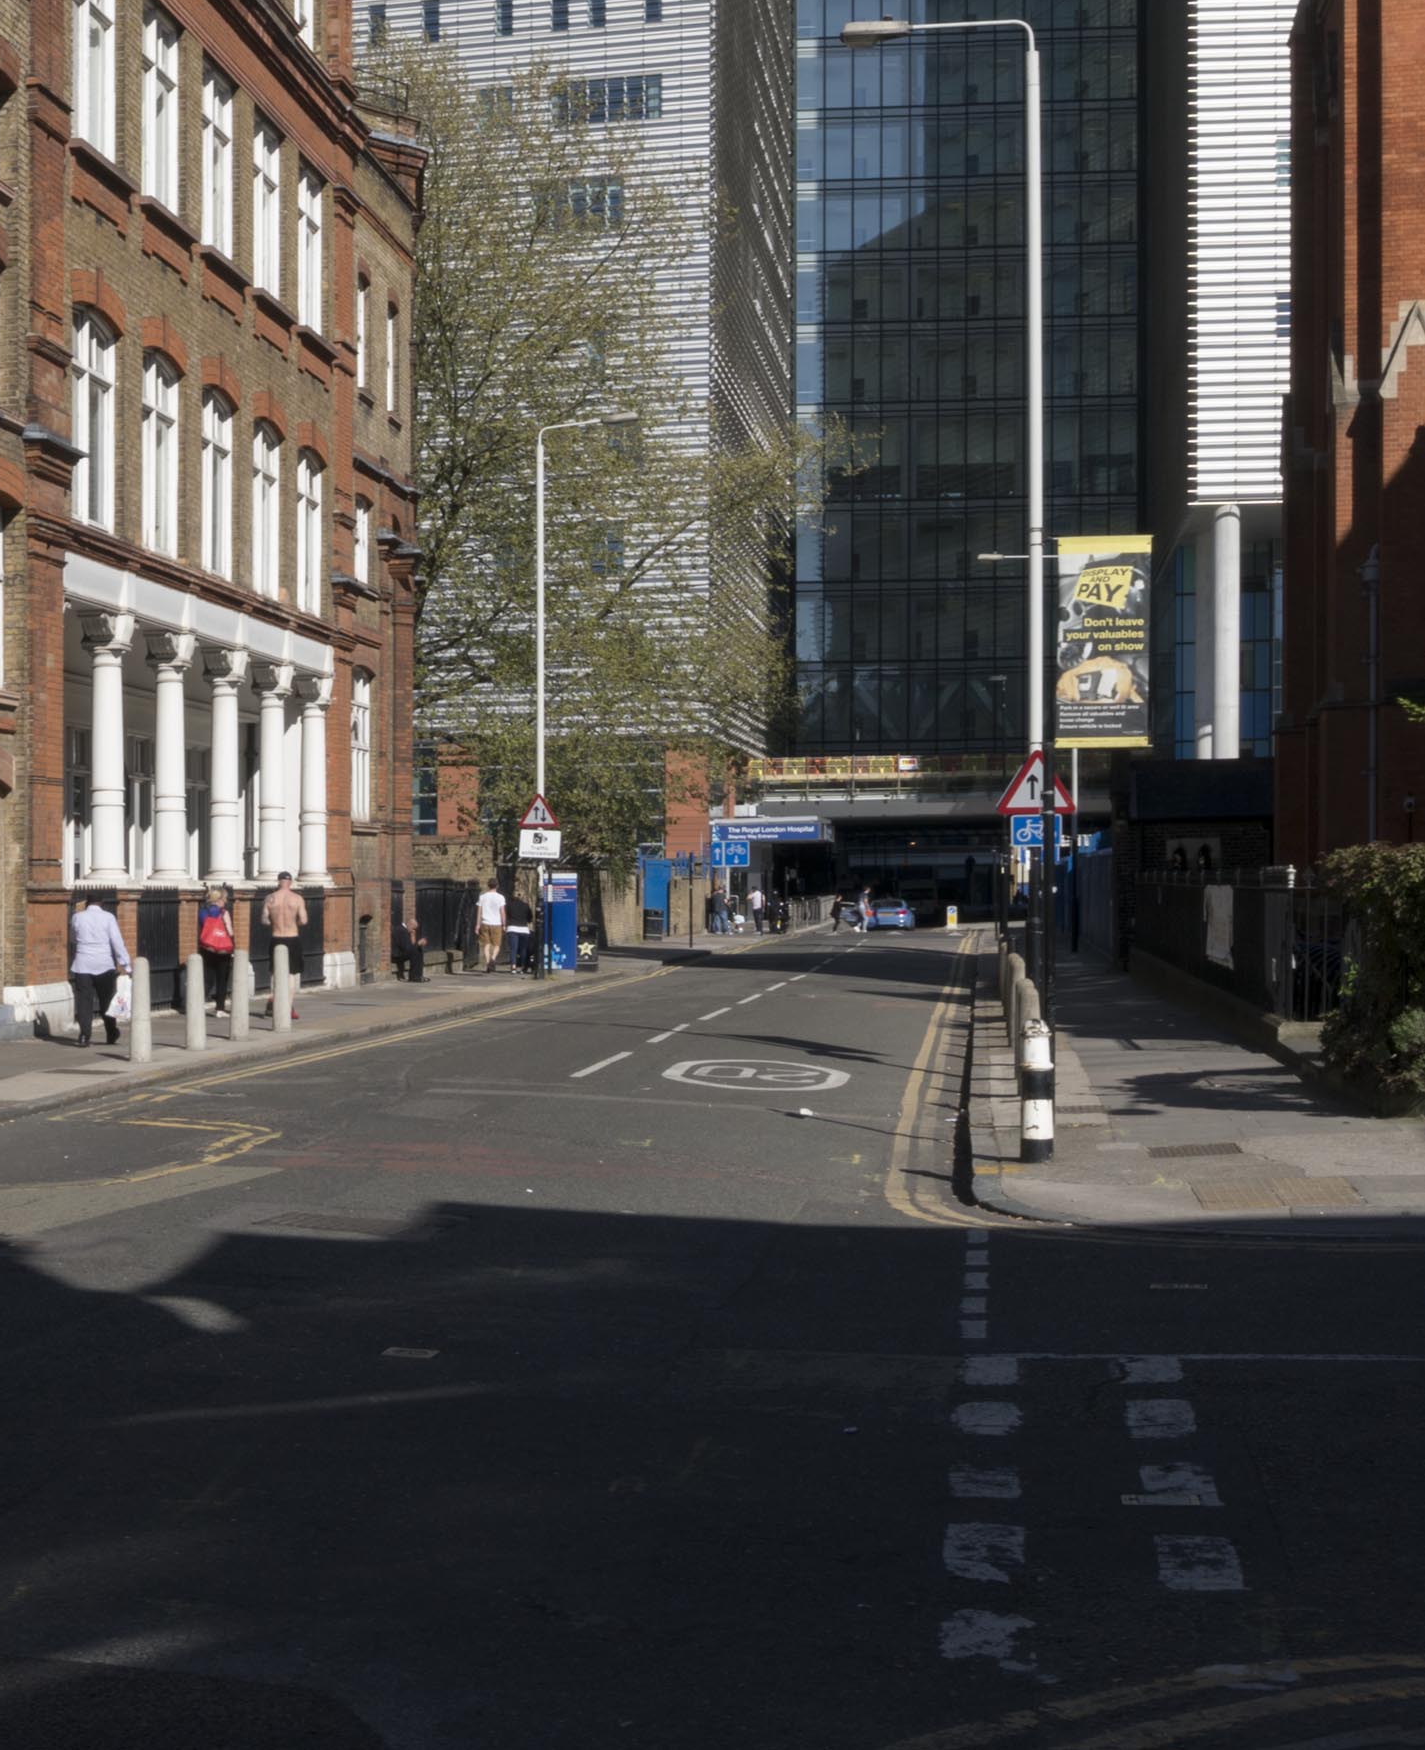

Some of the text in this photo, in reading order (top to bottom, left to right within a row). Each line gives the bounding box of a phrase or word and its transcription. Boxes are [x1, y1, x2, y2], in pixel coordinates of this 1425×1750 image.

[1082, 568, 1129, 577] DISPLAY
[1077, 583, 1124, 602] PAY
[1083, 617, 1145, 627] Don't leave
[1065, 630, 1145, 641] your valuables
[1097, 641, 1144, 651] on show
[741, 826, 760, 834] Royal
[787, 825, 815, 834] Hospital
